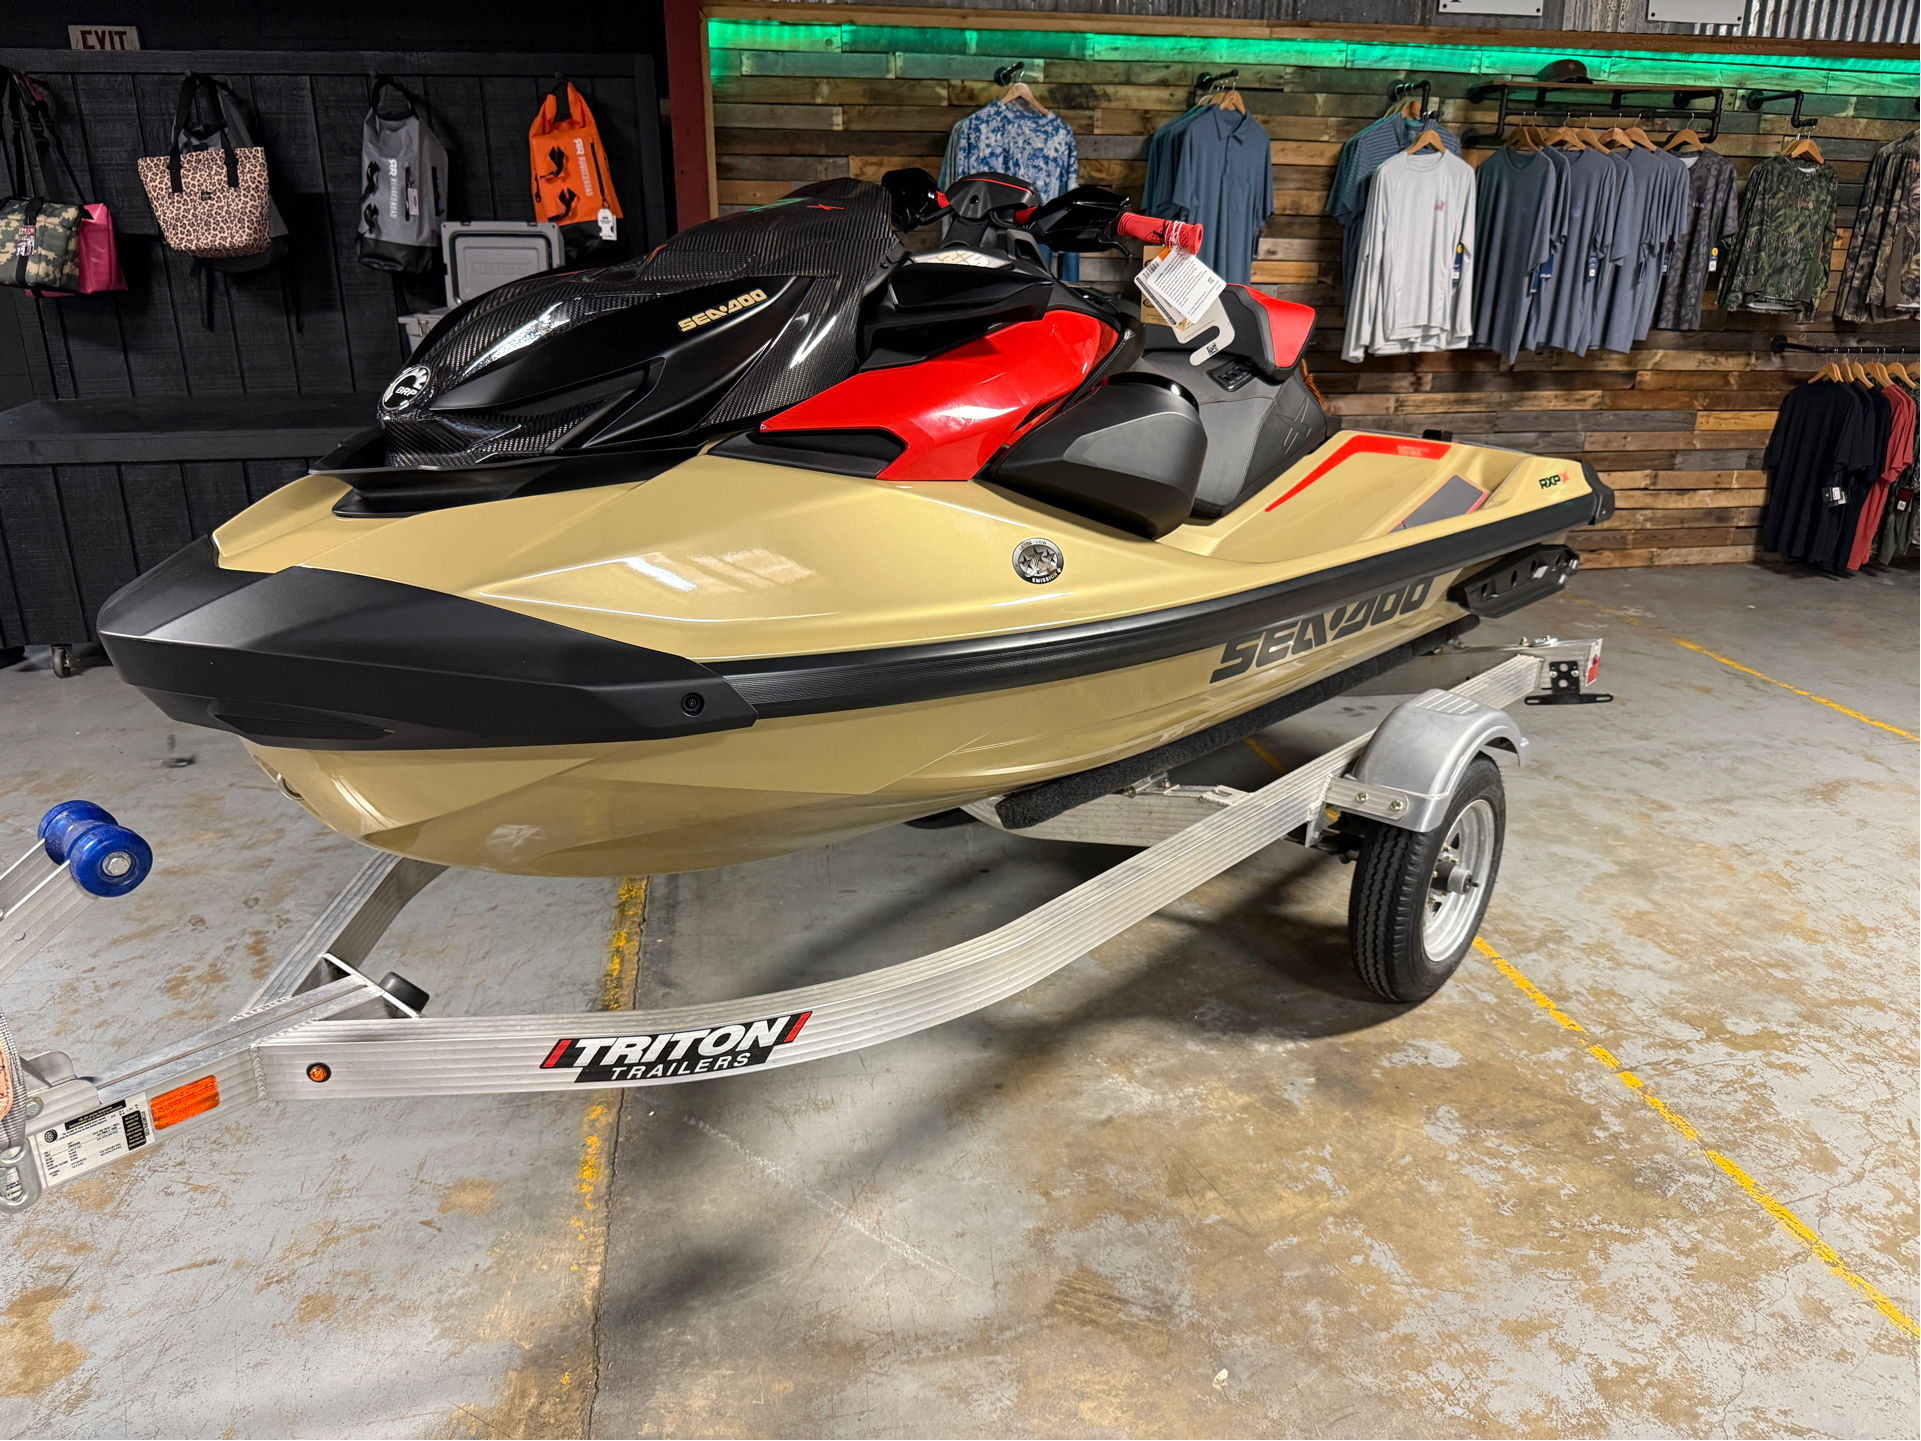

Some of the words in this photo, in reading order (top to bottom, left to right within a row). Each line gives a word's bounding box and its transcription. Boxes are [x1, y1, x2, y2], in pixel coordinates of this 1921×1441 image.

[395, 386, 418, 397] BRP
[573, 1015, 791, 1066] TRITON
[610, 1052, 750, 1080] TRAILERS
